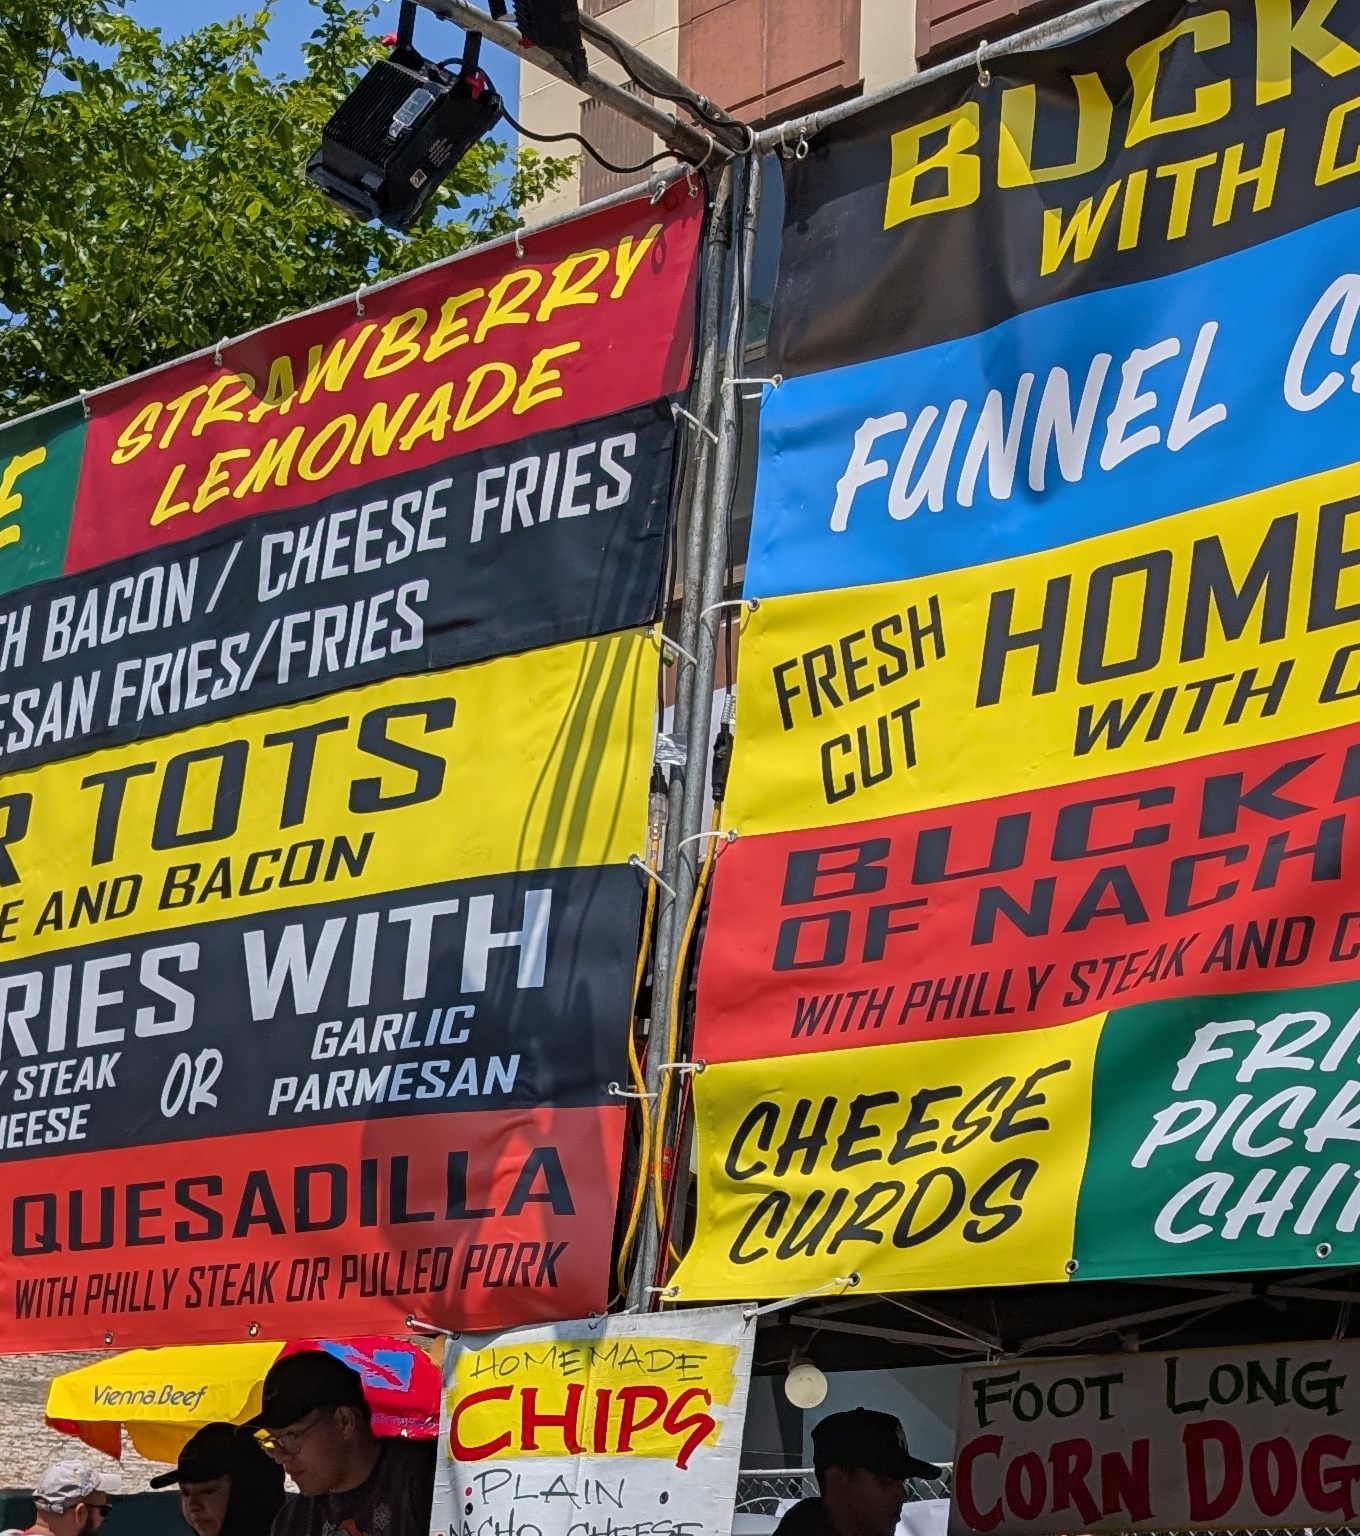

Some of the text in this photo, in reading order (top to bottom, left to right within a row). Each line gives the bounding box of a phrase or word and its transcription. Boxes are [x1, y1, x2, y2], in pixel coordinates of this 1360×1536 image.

[1040, 129, 1283, 277] WITH
[110, 223, 664, 465] STRAWBERRY
[149, 341, 582, 526] LEMONADE
[829, 320, 1228, 533] FUNNEL
[42, 556, 199, 662] BACON
[257, 477, 454, 603] CHEESE
[470, 432, 638, 544] FRIES
[108, 579, 430, 728] FRIES/FRIES
[772, 594, 946, 731] FRESH
[820, 699, 920, 804] CUT
[1074, 658, 1291, 759] WITH
[80, 697, 457, 867] TOTS
[33, 873, 144, 937] AND
[157, 832, 375, 910] BACON
[771, 898, 920, 973] OF
[242, 888, 552, 1021] WITH
[790, 995, 893, 1040] WITH
[898, 963, 1056, 1024] PHILLY
[1062, 933, 1204, 1009] STEAK
[1200, 914, 1316, 972] AND
[12, 1052, 123, 1101] STEAK
[160, 1048, 223, 1118] OR
[267, 1054, 522, 1116] PARMESAN
[311, 1004, 476, 1061] GARLIC
[723, 1058, 1072, 1181] CHEESE
[11, 1145, 577, 1257] QUESADILLA
[730, 1156, 1041, 1266] CURDS
[14, 1241, 570, 1320] WITH PHILLY STEAK OR PULLED PORK
[93, 1385, 208, 1411] Vienna Beef
[469, 1342, 708, 1381] HOMEMADE
[972, 1356, 1347, 1428] FOOT LONG
[449, 1383, 717, 1471] CHIPS
[473, 1468, 625, 1509] PLAIN
[955, 1434, 1157, 1532] CORN
